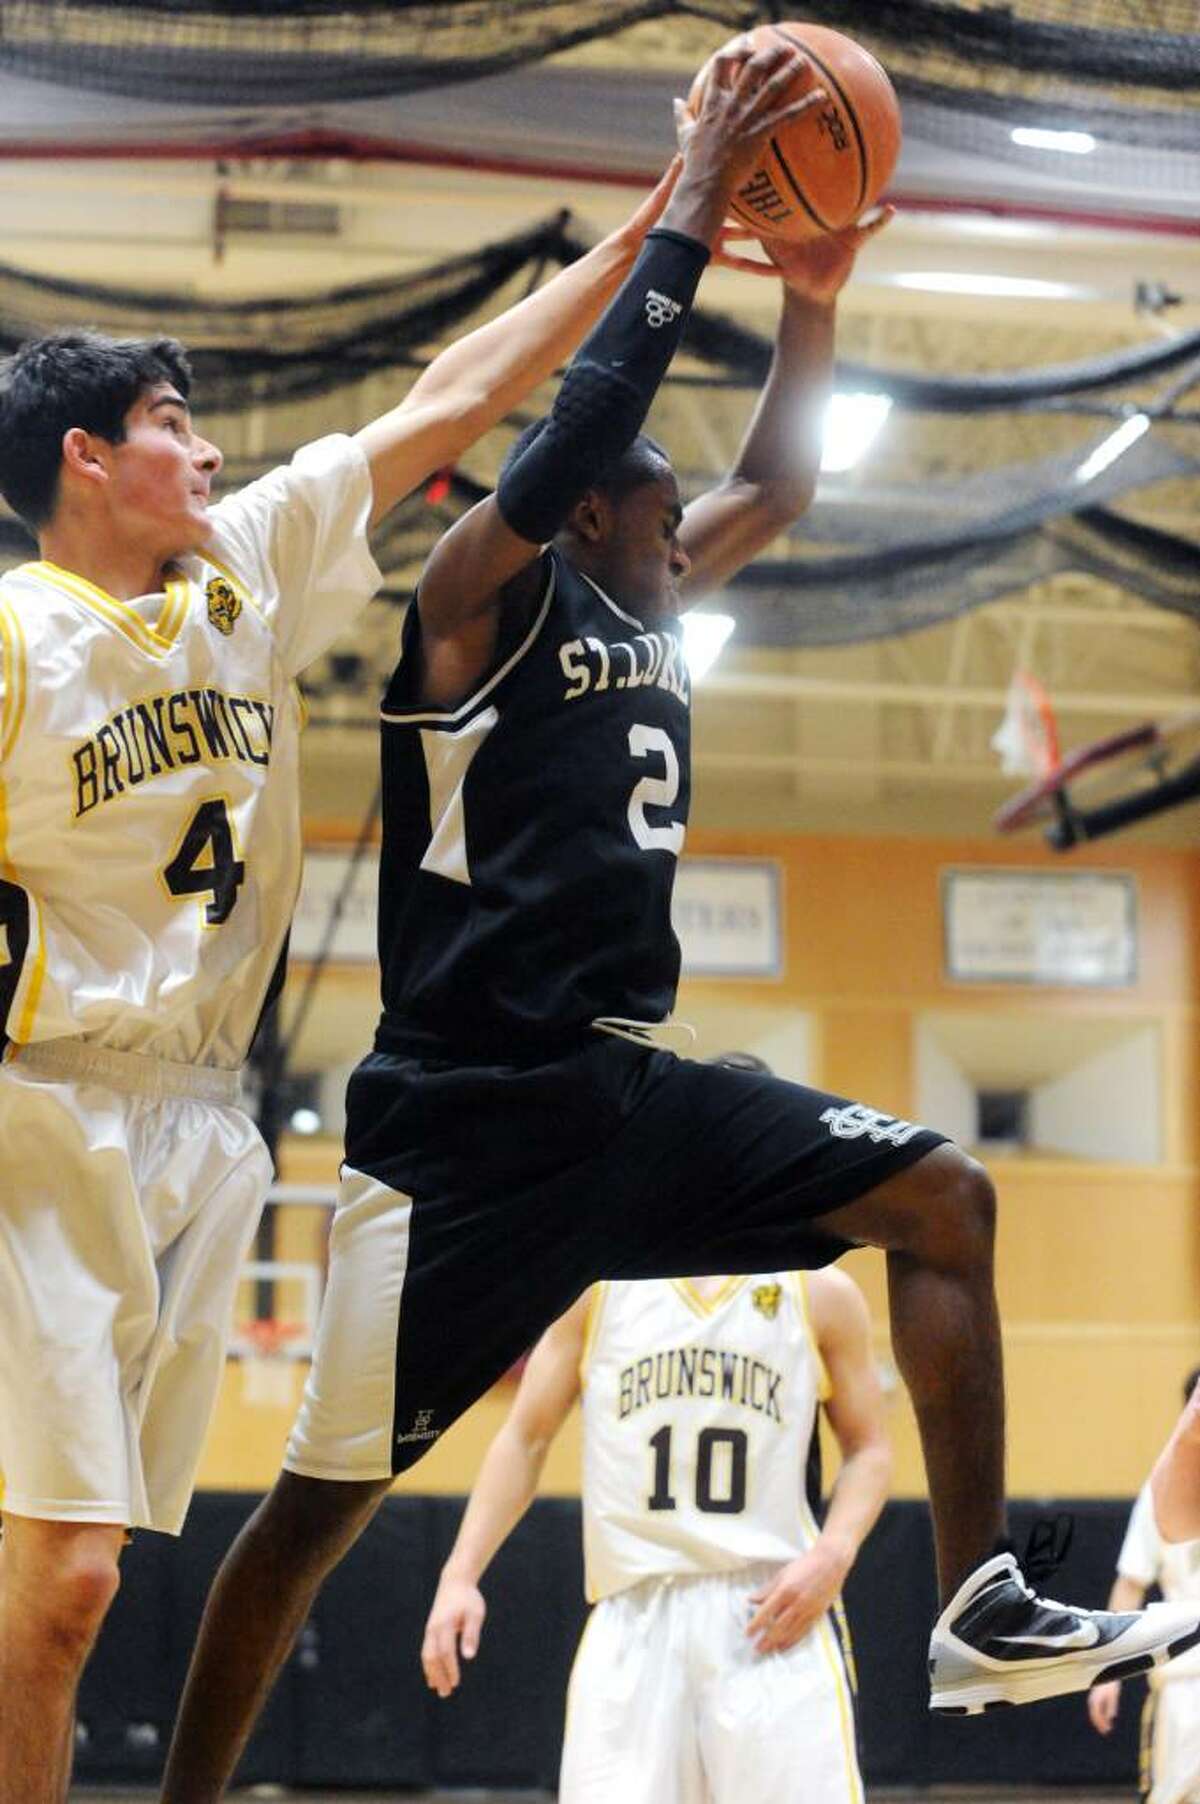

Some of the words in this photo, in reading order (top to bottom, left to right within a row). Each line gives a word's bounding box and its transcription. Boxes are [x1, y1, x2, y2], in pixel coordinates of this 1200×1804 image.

[738, 168, 793, 222] THE
[626, 723, 686, 855] 2
[164, 798, 245, 925] 4
[618, 1346, 783, 1424] BRUNSWICK
[647, 1424, 748, 1515] 10
